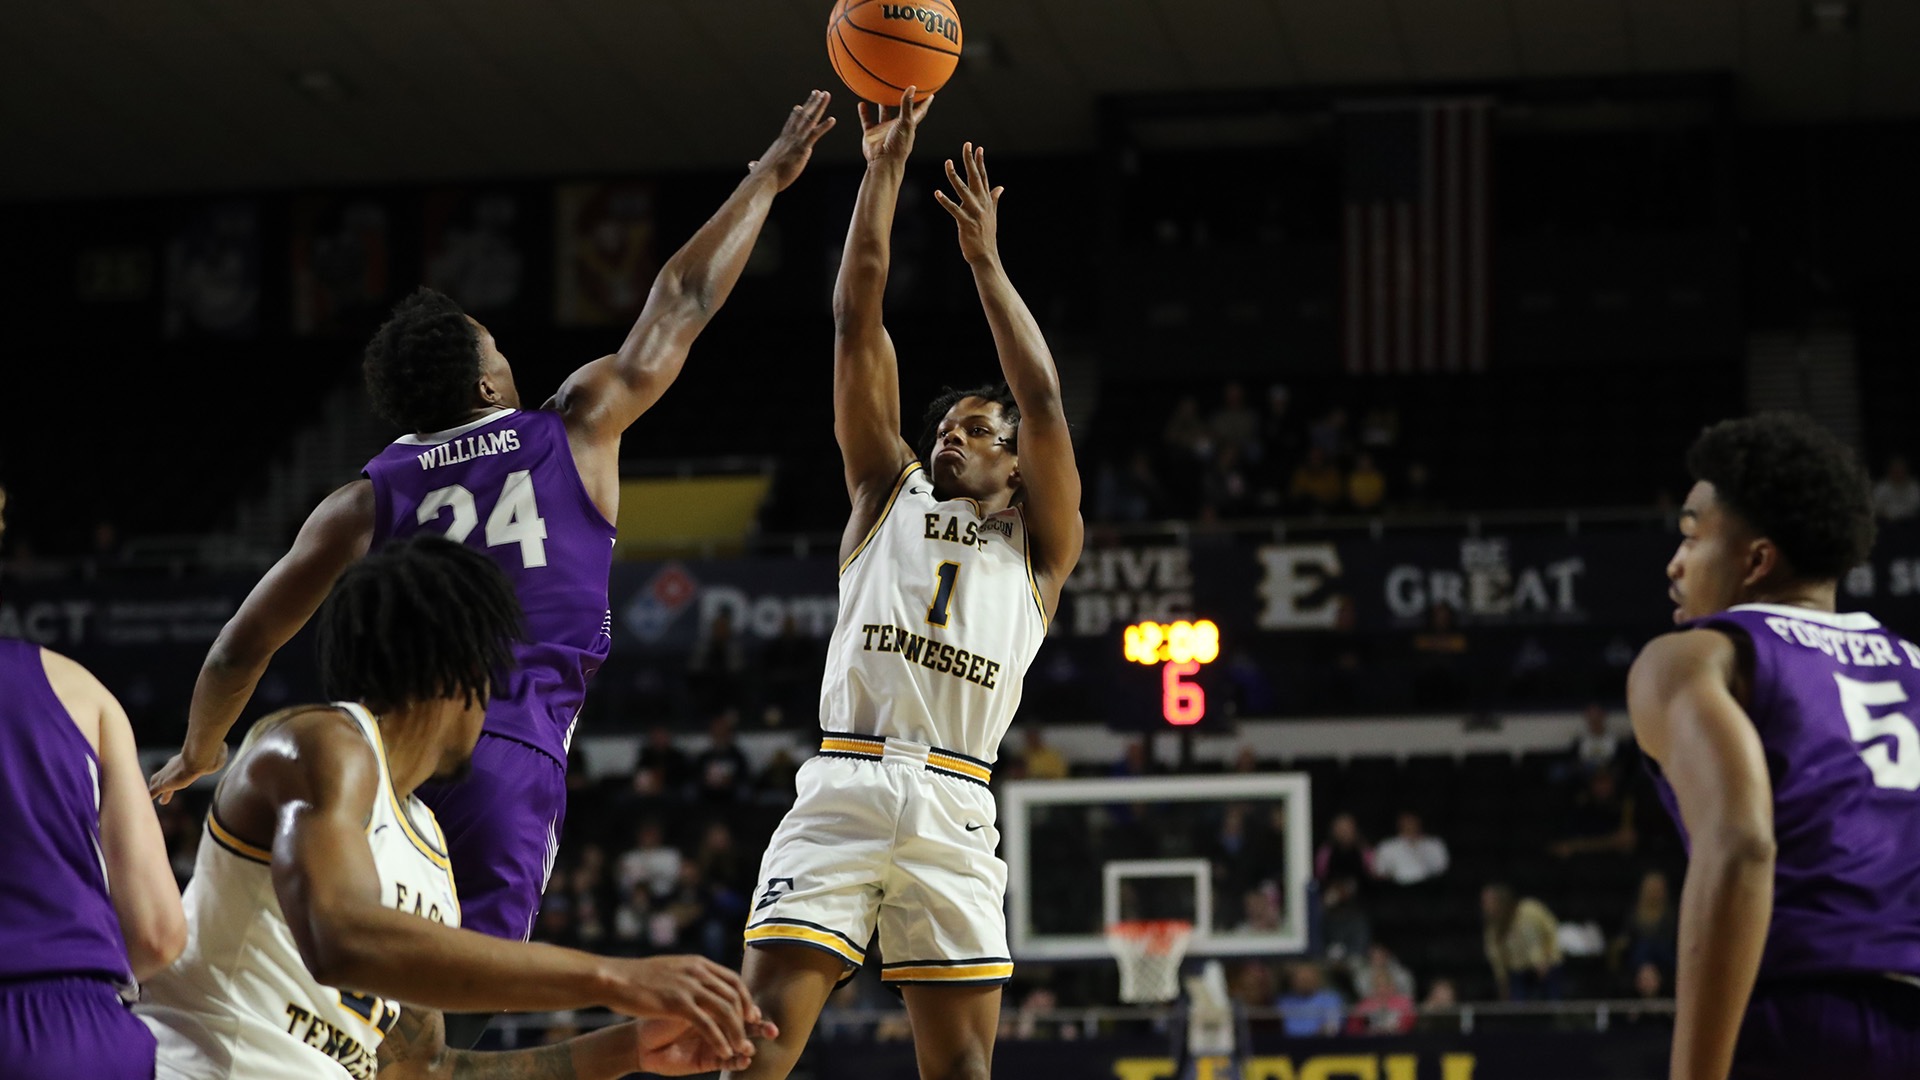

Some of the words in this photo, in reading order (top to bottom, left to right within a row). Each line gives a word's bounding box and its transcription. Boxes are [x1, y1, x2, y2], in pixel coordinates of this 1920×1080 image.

[882, 4, 958, 46] Wilson
[417, 428, 522, 471] WILLIAMS
[416, 469, 549, 569] 24
[924, 559, 961, 629] 1
[1253, 543, 1344, 632] E
[1384, 557, 1586, 619] GREAT
[862, 624, 1000, 690] TENNESSEE
[1765, 616, 1902, 667] FOSTER
[1163, 659, 1205, 725] 6
[1833, 671, 1920, 792] 5
